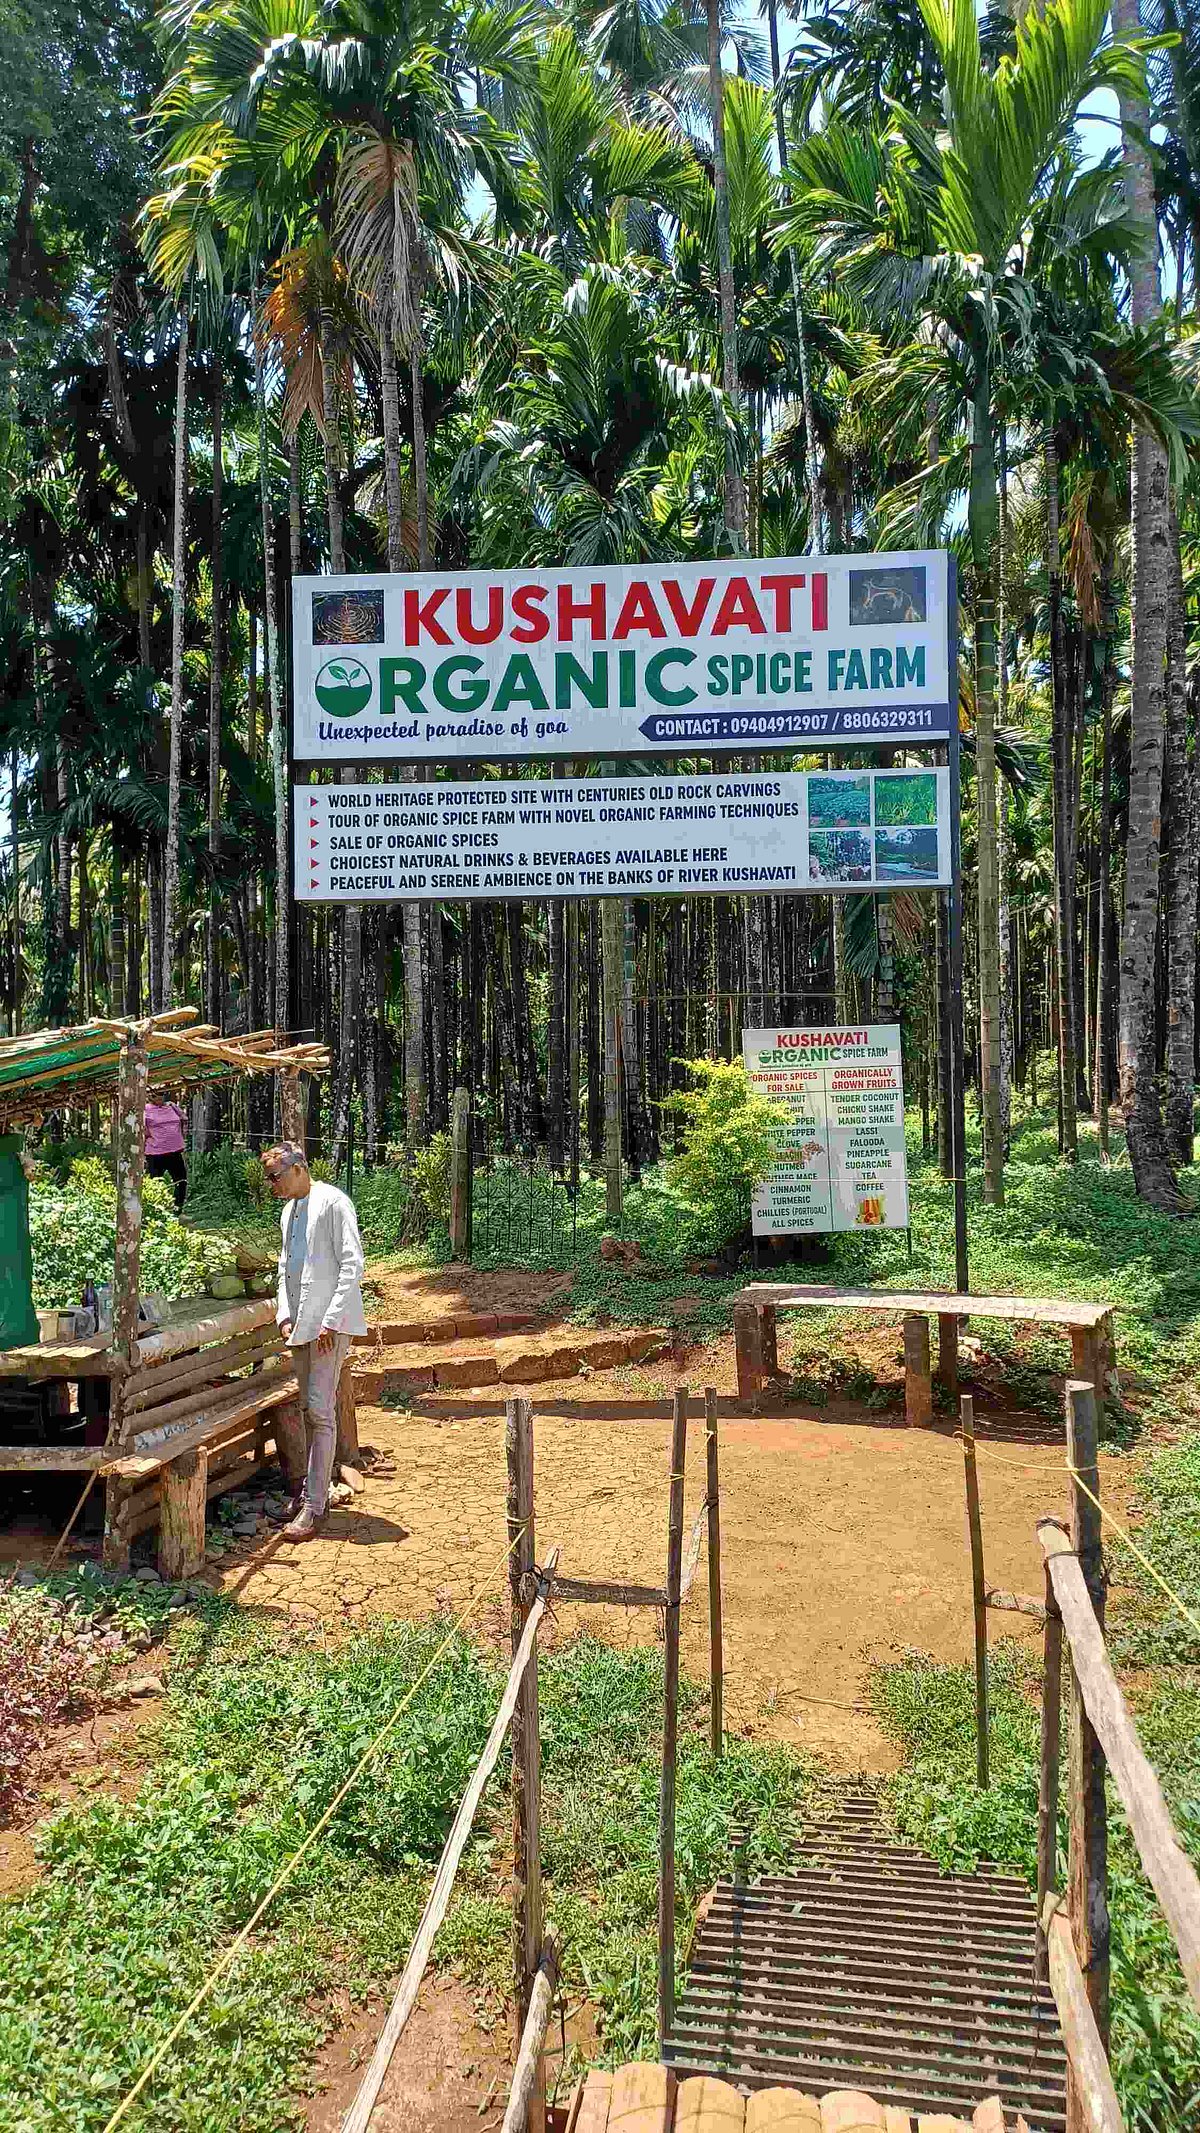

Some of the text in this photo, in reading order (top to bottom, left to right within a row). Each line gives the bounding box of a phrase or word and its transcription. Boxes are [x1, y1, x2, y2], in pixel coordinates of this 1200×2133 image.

[404, 572, 829, 647] KUSHAVATI
[707, 651, 813, 697] SPICE
[828, 646, 926, 691] FARM
[731, 713, 829, 735] 09404912907
[843, 709, 934, 730] 8806329311
[318, 717, 568, 743] Unexpected paradise of goa
[328, 783, 781, 808] WORLD HERITAGE PROTECTED SITE WITH CENTURIES OLD ROCK CARVINGS
[328, 803, 799, 829] TOUR OF ORGANIC SPICE FARM WITH NOVEL ORGANIC FARMING TECHNIQUES
[330, 833, 499, 850] SALE OF ORGANIC SPICES
[330, 847, 728, 870] CHOICEST NATURAL DRINKS & BEVERAGES AVAILABLE HERE
[330, 866, 796, 890] PEACEFUL AND SERENE AMBIENCE ON THE BANKS OF RIVER KUSHAVATI
[777, 1031, 868, 1048] KUSHAVATI
[843, 1048, 866, 1059] SPICE
[867, 1047, 889, 1058] FARM
[752, 1072, 818, 1082] ORGANIC SPICES
[834, 1068, 893, 1079] ORGANICALLY
[767, 1083, 805, 1092] FOR SALE
[831, 1079, 897, 1090] GROWN FRUITS
[831, 1092, 900, 1103] TENDER COCONUT
[837, 1103, 895, 1114] CHICKU SHAKE
[786, 1116, 816, 1126] PPER
[838, 1115, 895, 1125] MANGO SHAKE
[786, 1128, 816, 1137] PEPPER
[856, 1127, 878, 1136] LASSI
[776, 1139, 801, 1148] CLOVE
[850, 1137, 885, 1147] FALOODA
[846, 1149, 890, 1158] PINEAPPLE
[774, 1162, 805, 1171] NUTMEG
[845, 1160, 893, 1170] SUGARCANE
[861, 1172, 877, 1180] TEA
[770, 1185, 812, 1194] CINNAMON
[855, 1182, 884, 1192] COFFEE
[772, 1196, 811, 1205] TURMERIC
[757, 1205, 827, 1217] CHILLIES (PORTUGAL)
[771, 1218, 815, 1228] ALL SPICES
